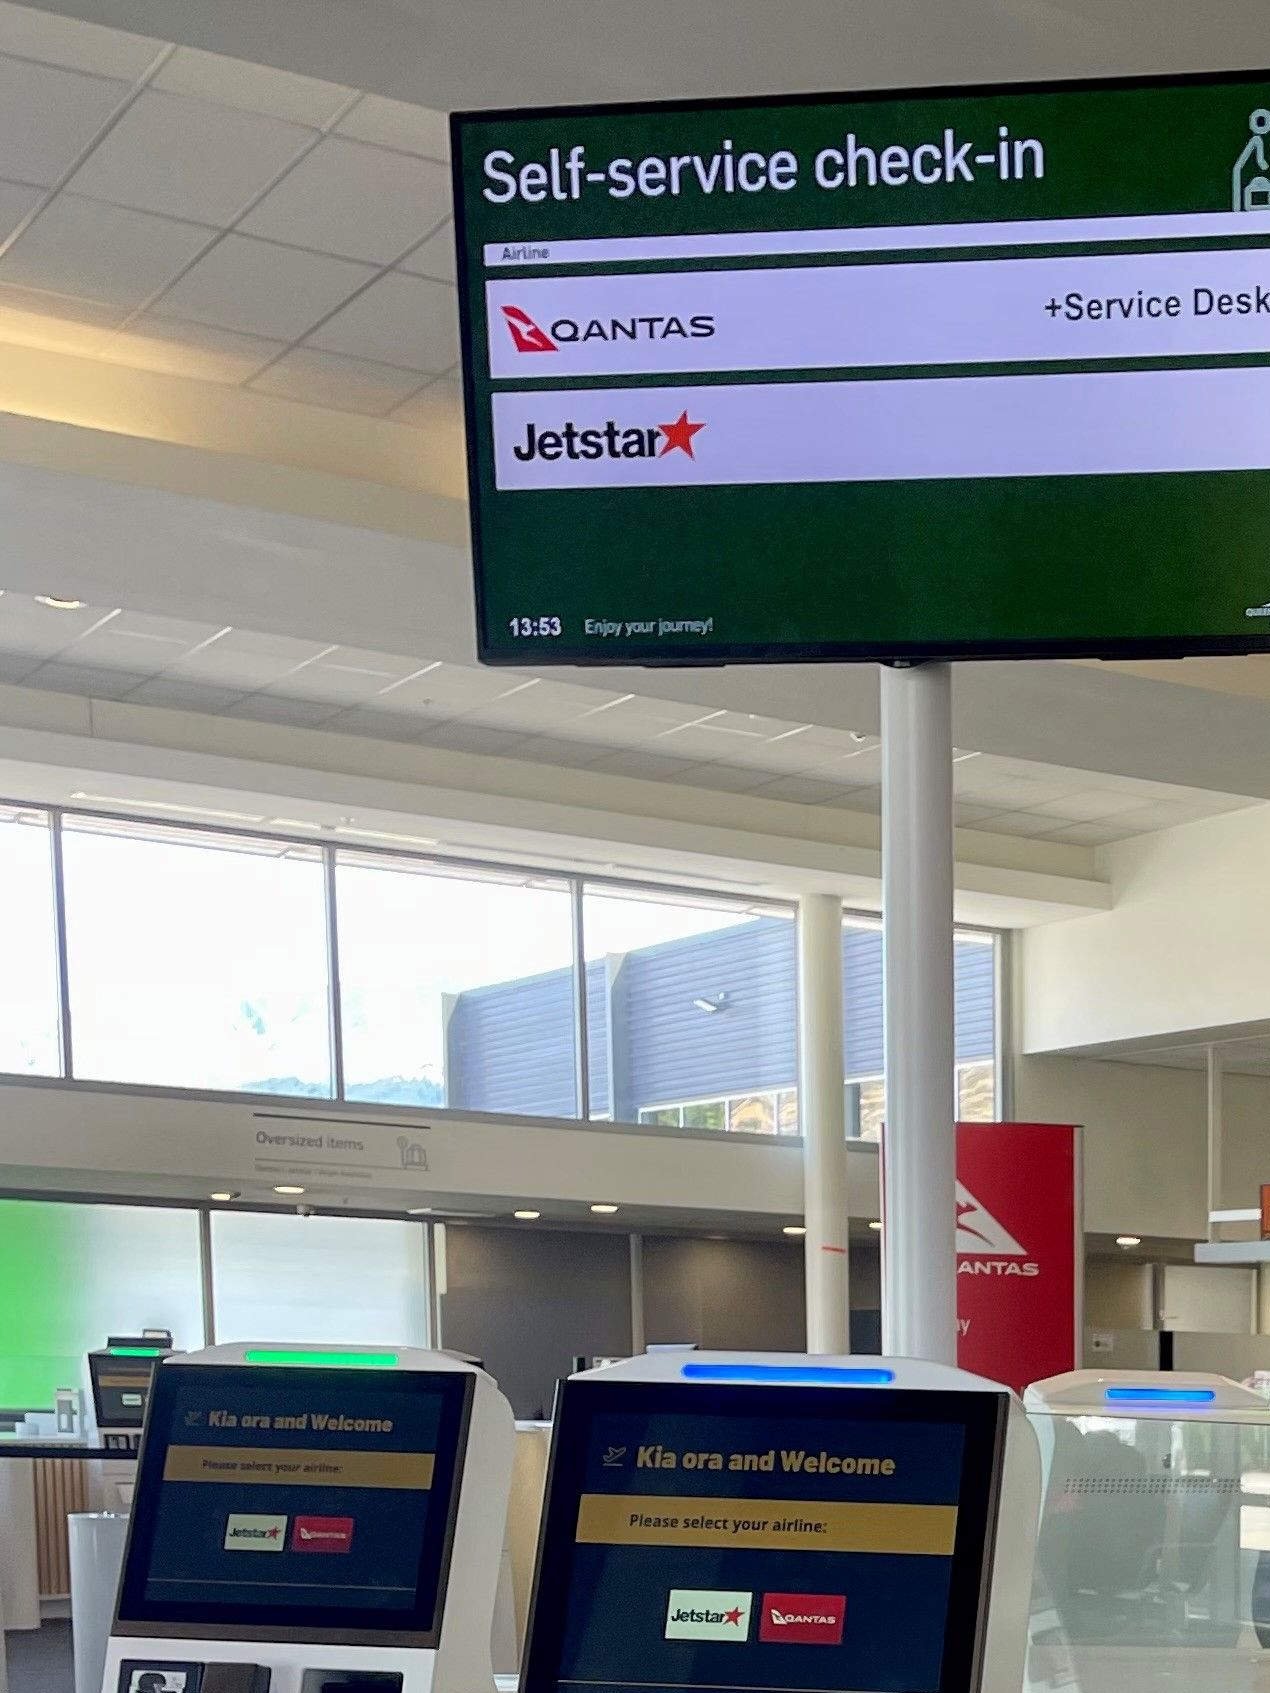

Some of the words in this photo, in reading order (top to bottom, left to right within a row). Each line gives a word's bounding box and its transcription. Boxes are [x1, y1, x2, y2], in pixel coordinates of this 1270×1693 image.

[482, 139, 798, 204] Self-service
[814, 126, 1045, 190] check-in
[502, 247, 549, 261] Airline
[1044, 291, 1181, 320] +Service
[1193, 286, 1270, 315] Desk
[551, 316, 715, 342] QANTAS
[513, 421, 662, 461] Jetstar
[509, 616, 562, 637] 13:53
[584, 618, 621, 637] Enjoy
[625, 620, 656, 637] your
[658, 617, 714, 636] journey!
[256, 1131, 323, 1149] Oversized
[326, 1134, 364, 1151] items
[958, 1261, 1039, 1276] ANTAS
[209, 1410, 237, 1427] Kia
[241, 1416, 270, 1428] ora
[273, 1413, 309, 1430] and
[311, 1413, 393, 1432] Welcome
[202, 1458, 237, 1470] Please
[240, 1461, 272, 1473] select
[275, 1464, 300, 1475] your
[636, 1445, 677, 1468] Kia
[682, 1451, 723, 1470] ora
[728, 1450, 775, 1471] and
[780, 1450, 896, 1476] Welcome
[629, 1514, 679, 1529] Please
[682, 1515, 728, 1530] select
[732, 1520, 769, 1534] your
[772, 1518, 828, 1534] airline:
[671, 1608, 726, 1623] Jetstar
[785, 1614, 836, 1625] QANTAS
